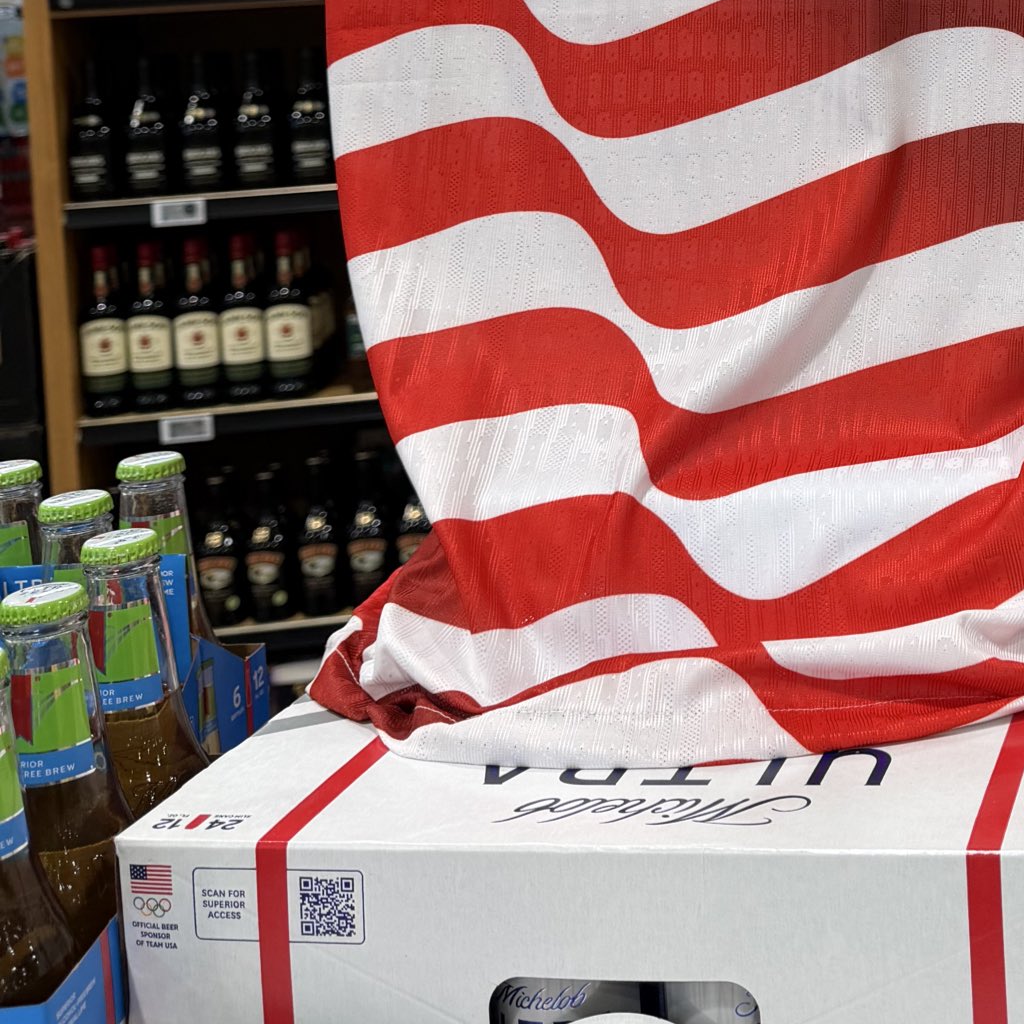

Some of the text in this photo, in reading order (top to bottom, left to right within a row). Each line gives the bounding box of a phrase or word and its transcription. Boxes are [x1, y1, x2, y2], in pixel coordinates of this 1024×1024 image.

[116, 693, 143, 704] BREW
[232, 684, 241, 708] 6
[45, 763, 75, 776] BREW
[491, 794, 811, 825] Michelob
[152, 818, 244, 830] 24 12
[201, 889, 246, 898] SCAN FOR
[202, 899, 246, 909] SUPERIOR
[207, 911, 242, 920] ACCESS
[132, 921, 179, 931] OFFICIAL BEER
[140, 931, 171, 940] SPONSOR
[136, 939, 178, 950] OF TEAM USA
[500, 982, 592, 1011] Michelob
